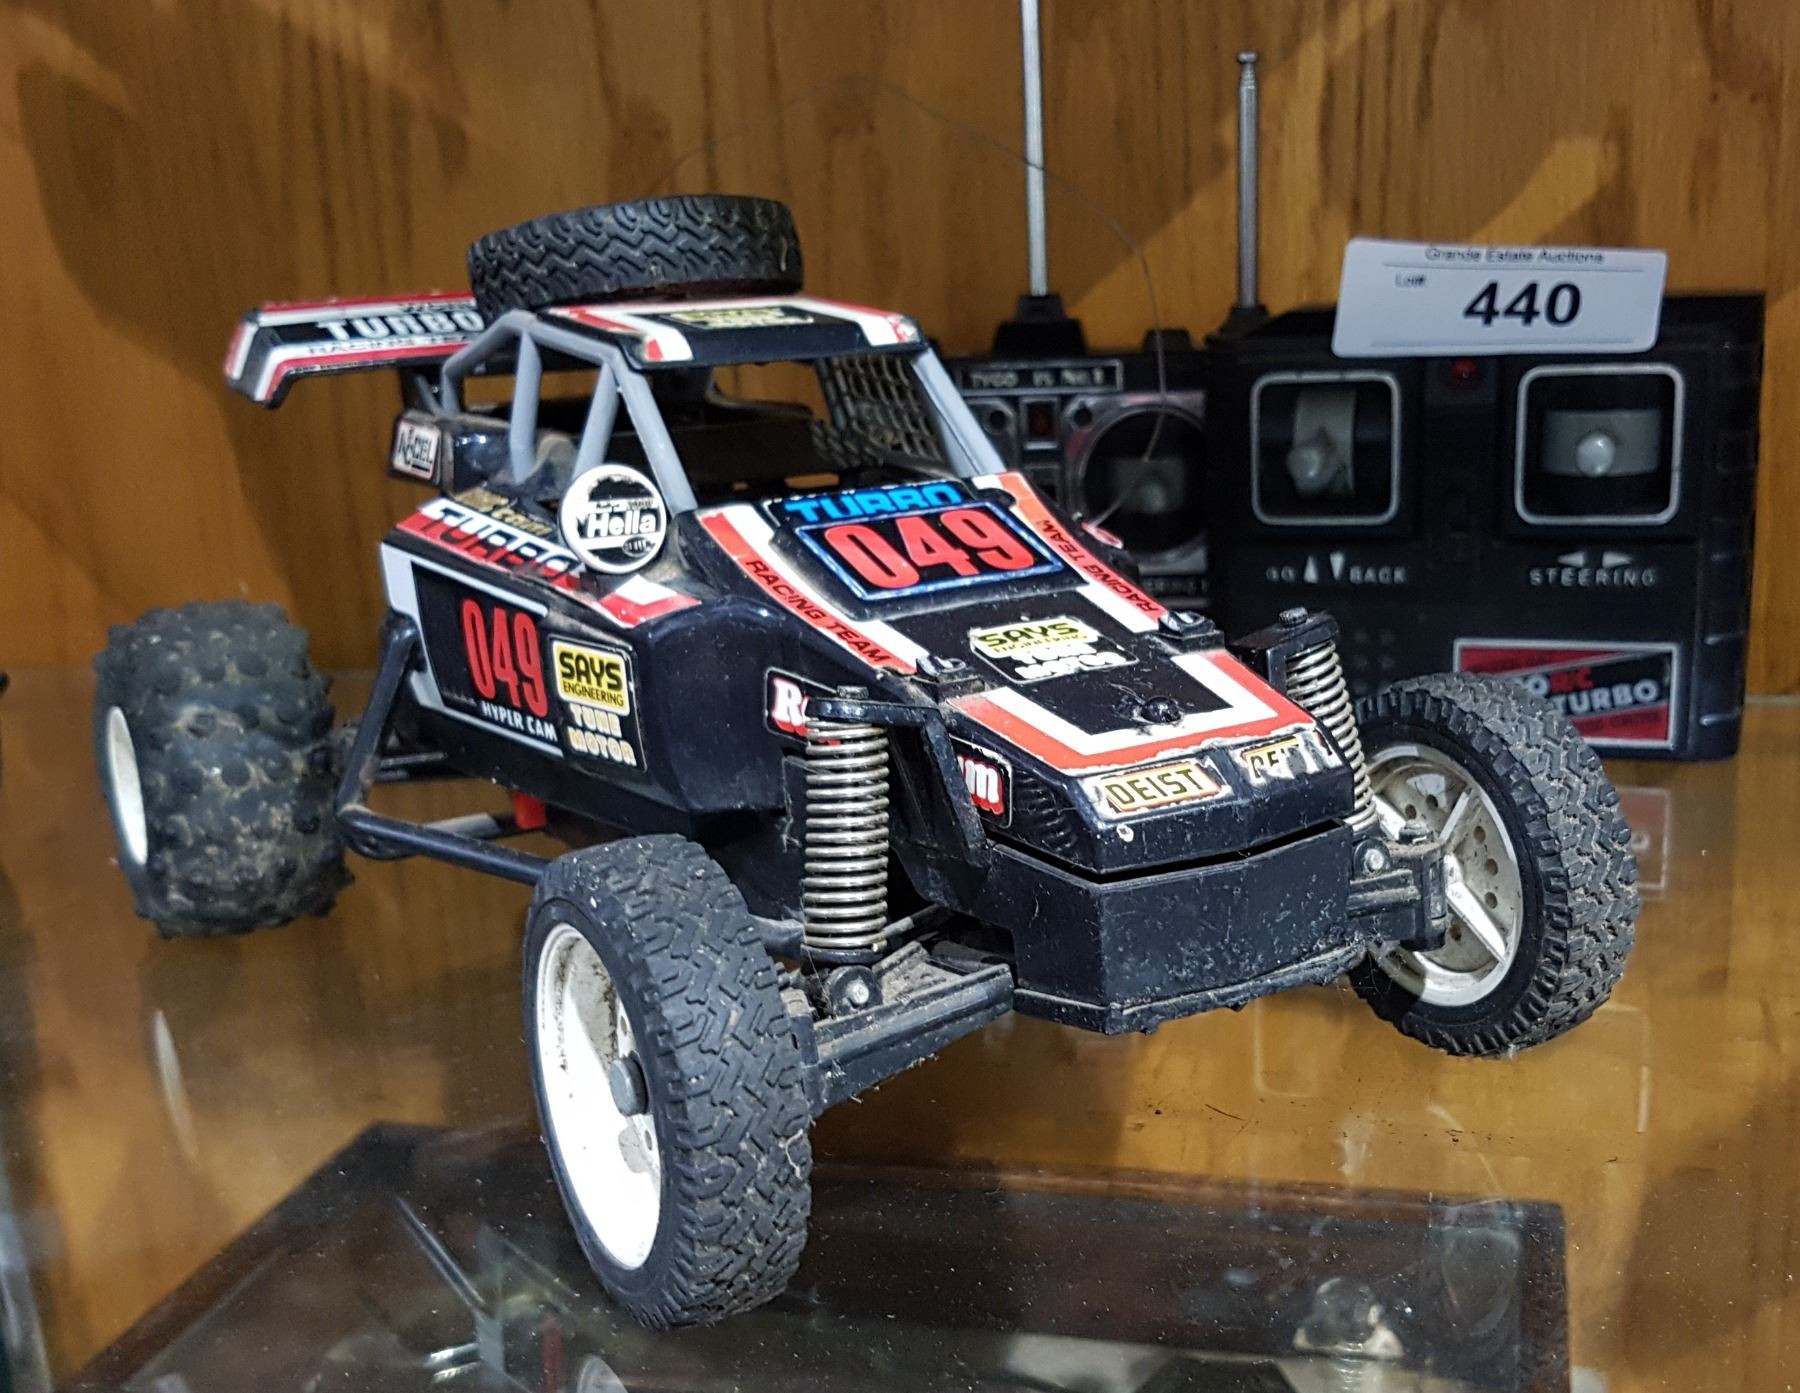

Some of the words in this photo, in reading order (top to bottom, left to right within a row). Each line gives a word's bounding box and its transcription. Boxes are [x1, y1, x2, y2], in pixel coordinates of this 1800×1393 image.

[1463, 280, 1581, 327] 440
[317, 310, 486, 342] TURBO
[785, 484, 964, 523] TURBO
[586, 511, 657, 538] Hella
[824, 508, 1036, 589] 049
[1083, 563, 1160, 613] RACING
[1349, 566, 1406, 584] BACK
[1529, 567, 1657, 588] STEERING
[744, 560, 826, 621] RACING
[823, 620, 892, 663] TEAM
[977, 622, 1079, 648] SAYS
[462, 600, 549, 718] 049
[558, 651, 623, 692] SAYS
[562, 680, 625, 708] ENGINEERING
[1553, 679, 1659, 716] TURBO
[481, 699, 525, 733] HYPER
[525, 715, 559, 743] CAM
[566, 725, 638, 767] MOTOR
[1104, 768, 1205, 805] DEIST
